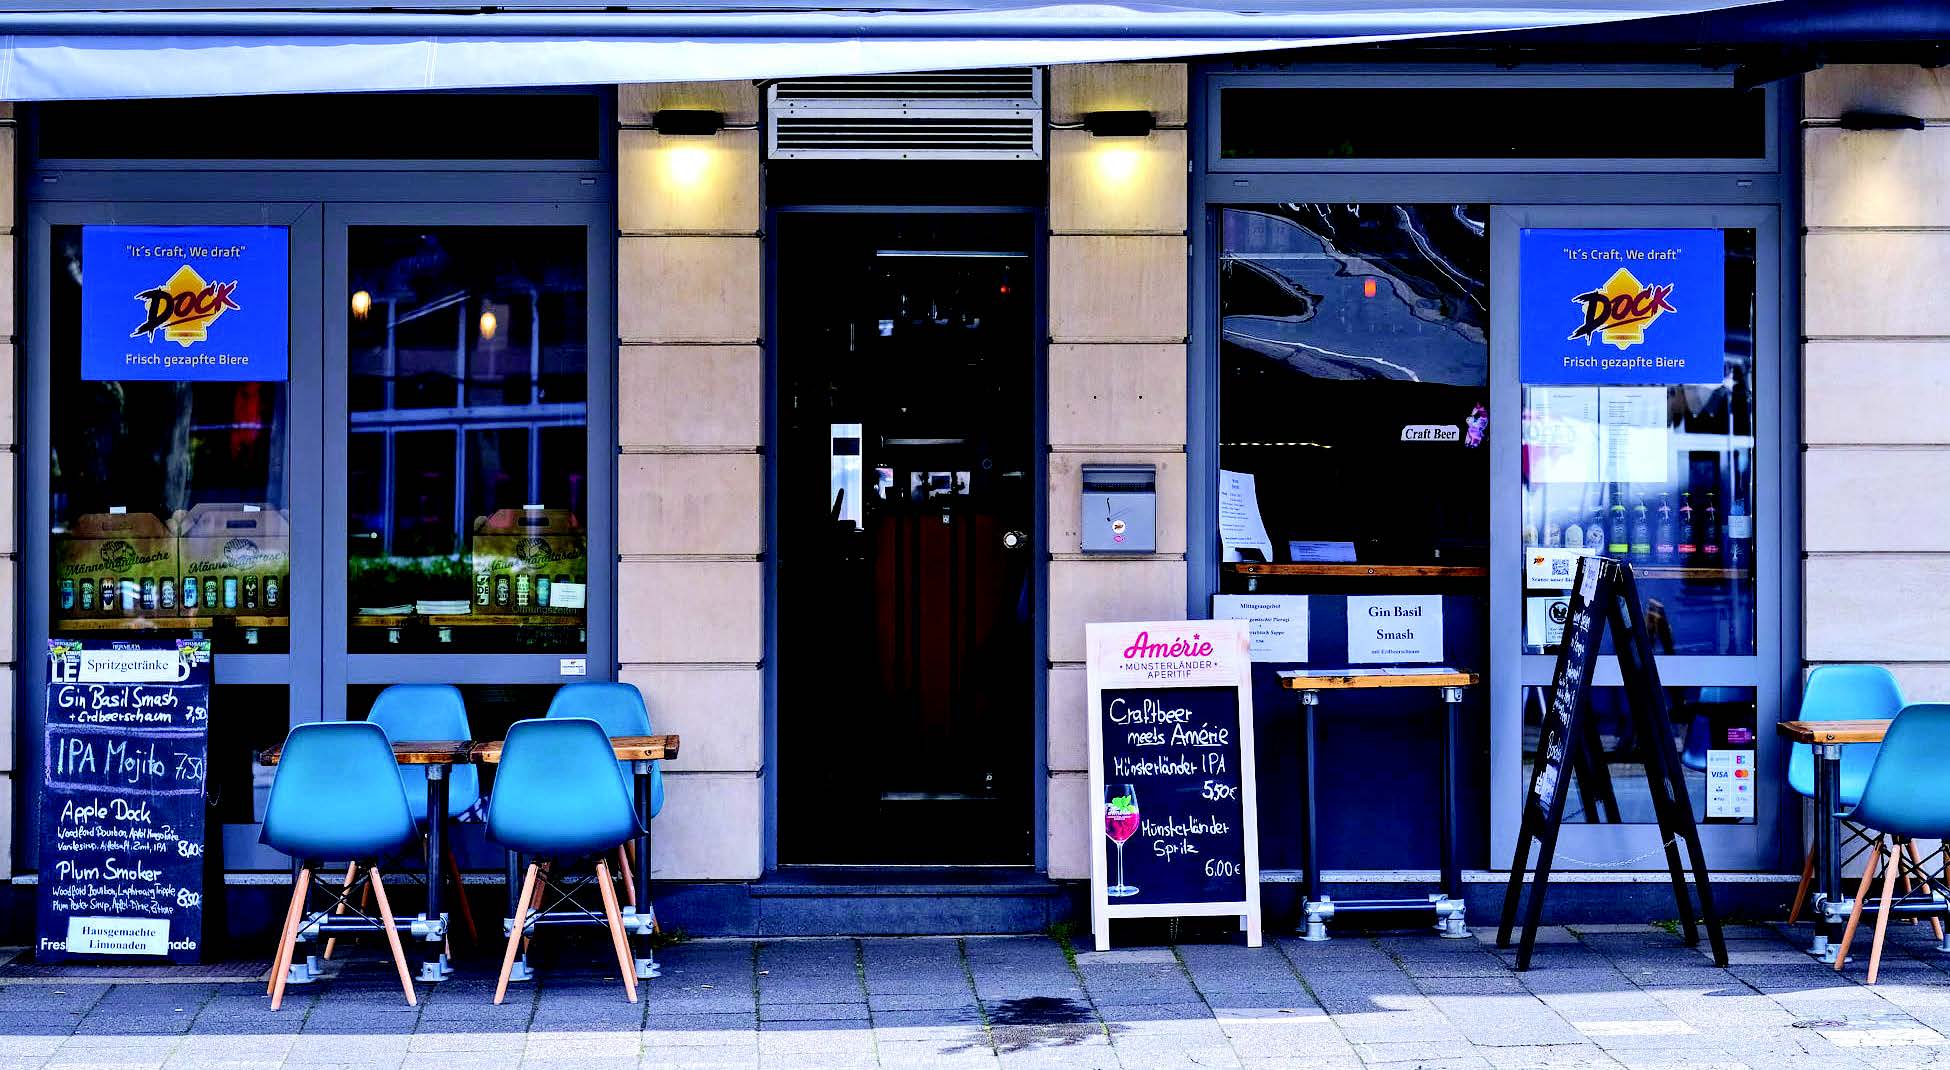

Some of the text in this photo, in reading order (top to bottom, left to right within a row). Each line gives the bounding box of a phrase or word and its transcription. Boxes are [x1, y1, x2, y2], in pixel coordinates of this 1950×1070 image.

[154, 246, 187, 258] Craft,
[189, 246, 208, 257] We
[210, 245, 247, 257] draft"
[1591, 248, 1623, 261] Craft,
[1625, 249, 1645, 260] We
[1647, 248, 1682, 260] draft"
[126, 354, 249, 368] Frisch gezapfte Biere
[1563, 356, 1686, 370] Frisch gezapfte Biere
[1405, 428, 1457, 440] Craft Beer
[1368, 605, 1422, 618] Gin Basil
[1376, 628, 1415, 641] Smash
[1124, 631, 1214, 659] Amérie
[87, 659, 170, 673] Spritzgetränke
[1125, 659, 1213, 671] MÜNSTERLÄNDER
[1147, 669, 1192, 679] APERITIF
[58, 685, 178, 710] Gin Basil Smash
[1109, 697, 1194, 725] Craftbeer
[1127, 726, 1166, 746] meets
[57, 737, 96, 776] IPA
[104, 740, 165, 783] Mojito
[1201, 752, 1226, 775] IPA
[60, 798, 152, 825] Apple Dock
[55, 857, 163, 881] Plum Smoker
[82, 926, 157, 939] Hausgemachte
[89, 939, 147, 951] Limonaden
